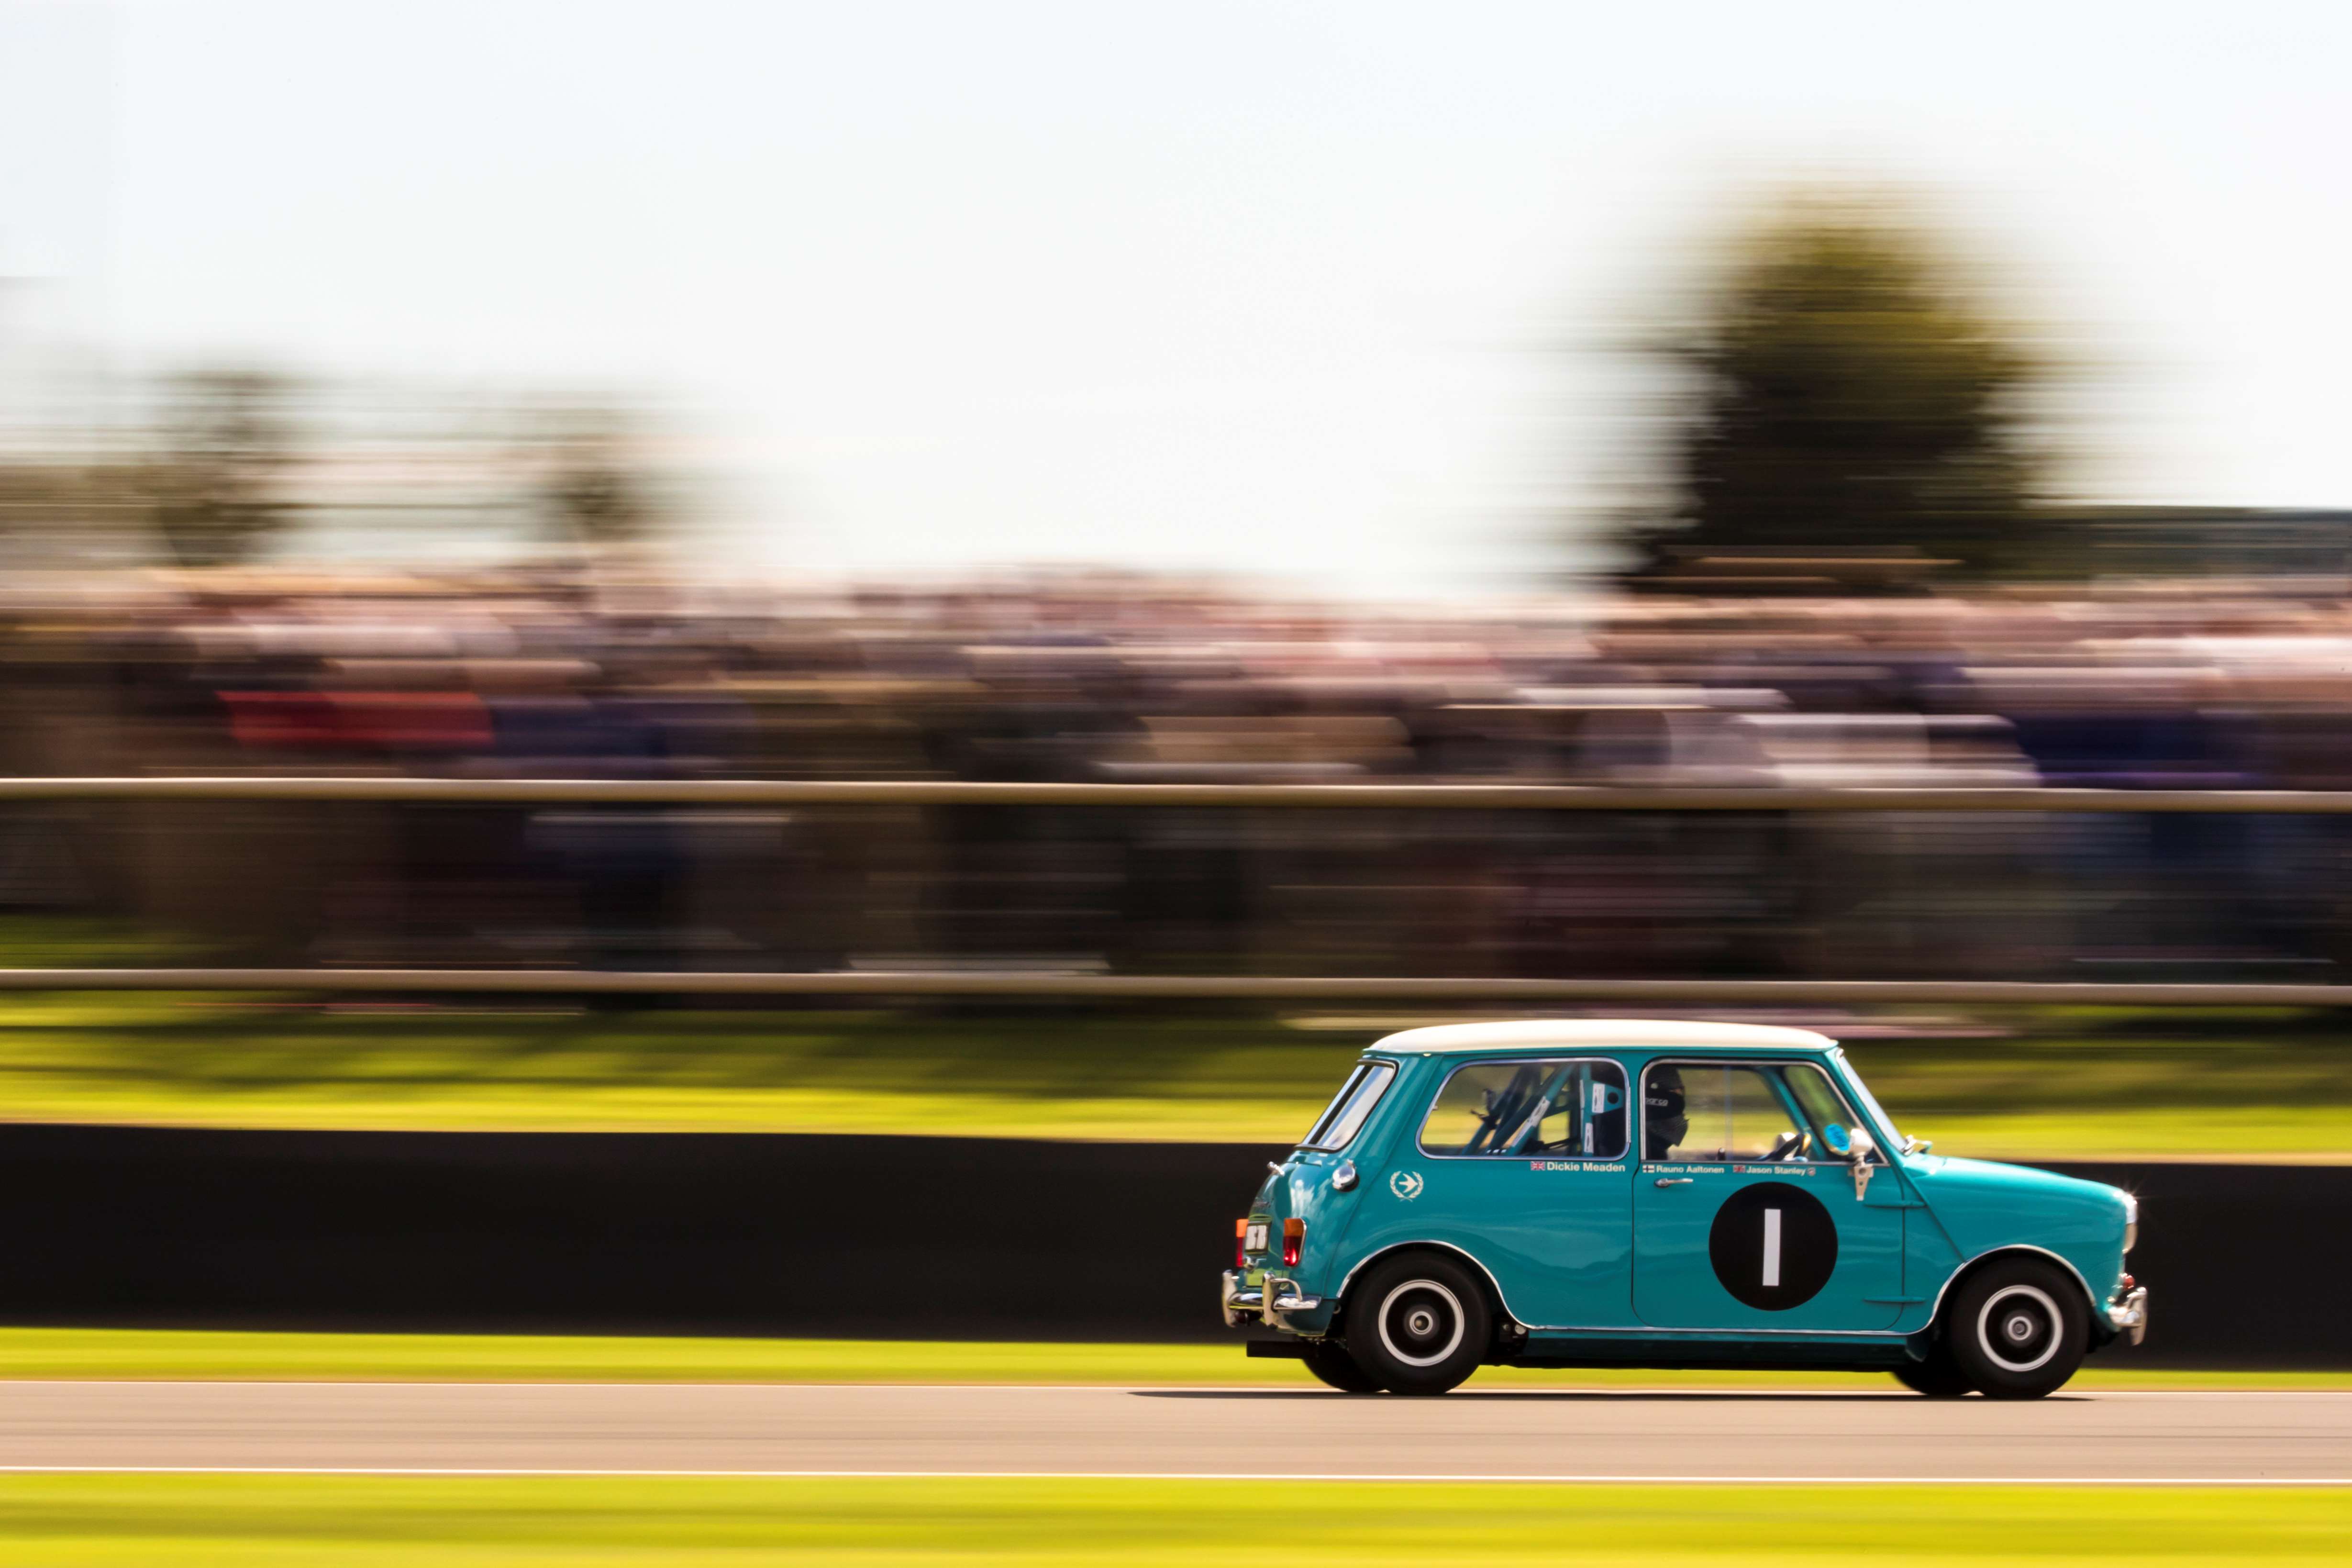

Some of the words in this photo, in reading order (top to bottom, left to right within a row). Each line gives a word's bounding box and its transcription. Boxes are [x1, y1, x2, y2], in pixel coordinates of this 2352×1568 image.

[1547, 1162, 1580, 1171] Dickie
[1583, 1162, 1625, 1172] Meaden
[1656, 1165, 1684, 1173] Rauno
[1775, 1167, 1806, 1177] Stanley
[1763, 1209, 1781, 1286] 1
